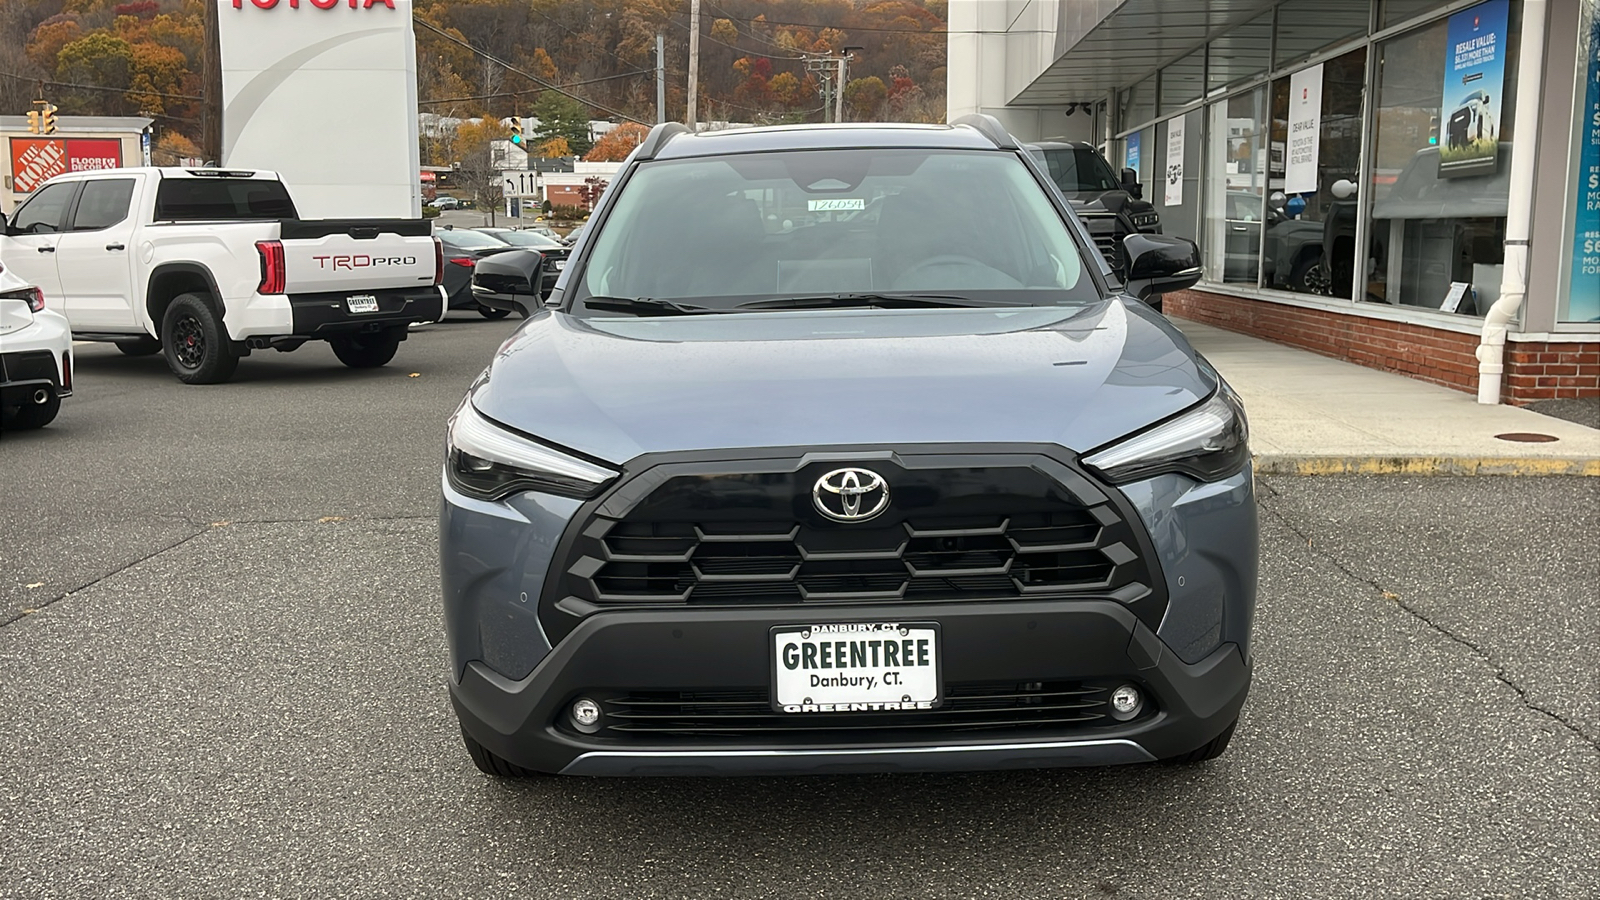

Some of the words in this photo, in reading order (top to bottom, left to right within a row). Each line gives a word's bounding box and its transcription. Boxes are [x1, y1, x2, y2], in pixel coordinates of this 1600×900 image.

[18, 143, 41, 166] THE
[71, 157, 102, 165] FLOOR
[14, 140, 65, 192] HOME
[312, 255, 371, 272] TRD
[372, 256, 417, 266] PRO
[348, 298, 376, 306] GREENTREE
[810, 624, 878, 634] DANBURY,
[782, 639, 930, 671] GREENTREE
[810, 672, 878, 690] Danbury,
[882, 672, 903, 686] CT.
[783, 701, 933, 713] GREENTREE
